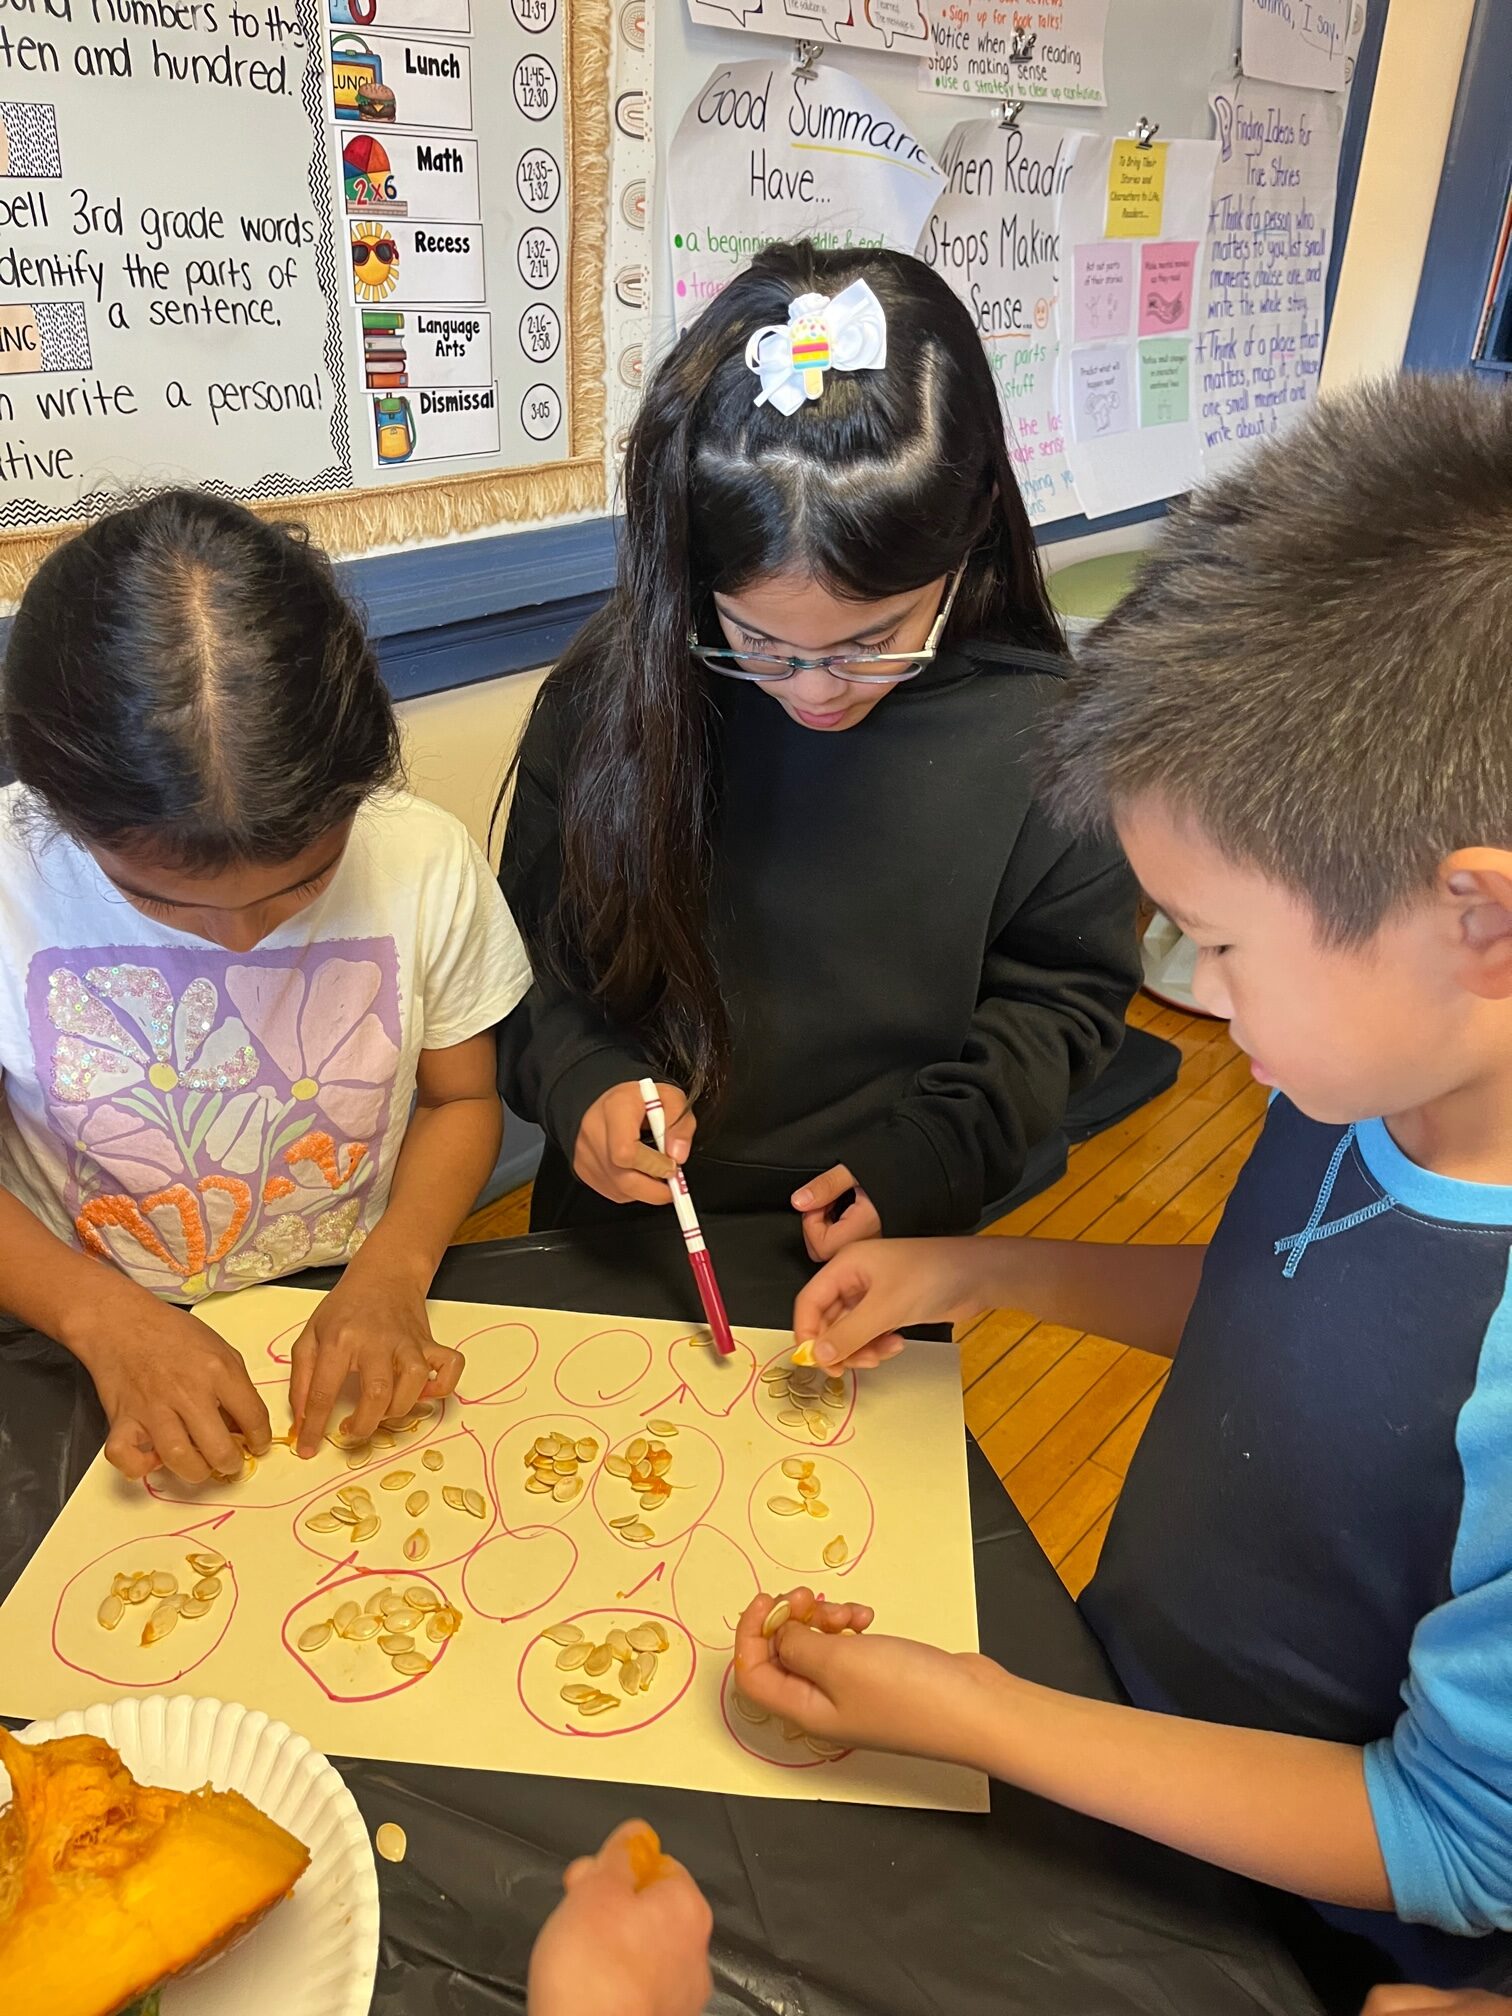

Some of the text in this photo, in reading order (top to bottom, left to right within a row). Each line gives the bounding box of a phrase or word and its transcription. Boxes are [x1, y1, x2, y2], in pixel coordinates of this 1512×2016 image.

[229, 0, 259, 38] to
[976, 11, 988, 28] up
[0, 25, 293, 96] ten and hundred.
[404, 47, 461, 80] Lunch
[930, 23, 971, 51] Notice
[977, 31, 1006, 55] when
[1041, 44, 1082, 74] reading
[968, 57, 1010, 84] making
[1017, 63, 1048, 82] sense
[697, 71, 774, 133] Good
[416, 144, 464, 174] Math
[750, 147, 832, 203] Have...
[528, 180, 550, 202] 1:32
[70, 188, 123, 236] 3rd
[140, 206, 225, 251] grade
[414, 230, 471, 254] Recess
[685, 231, 701, 253] a
[925, 214, 989, 282] Stops
[122, 253, 170, 291] the
[186, 258, 252, 296] parts
[268, 257, 298, 290] of
[529, 259, 549, 279] 2:14
[108, 296, 281, 330] a sentence.
[417, 315, 481, 344] Language
[531, 332, 551, 352] 2:58
[434, 339, 467, 358] Arts
[1014, 343, 1047, 373] parts
[36, 377, 138, 420] write
[166, 381, 192, 409] a
[208, 373, 324, 426] personal
[419, 389, 495, 415] Dismissal
[530, 401, 551, 421] 3:05
[1019, 417, 1038, 437] the
